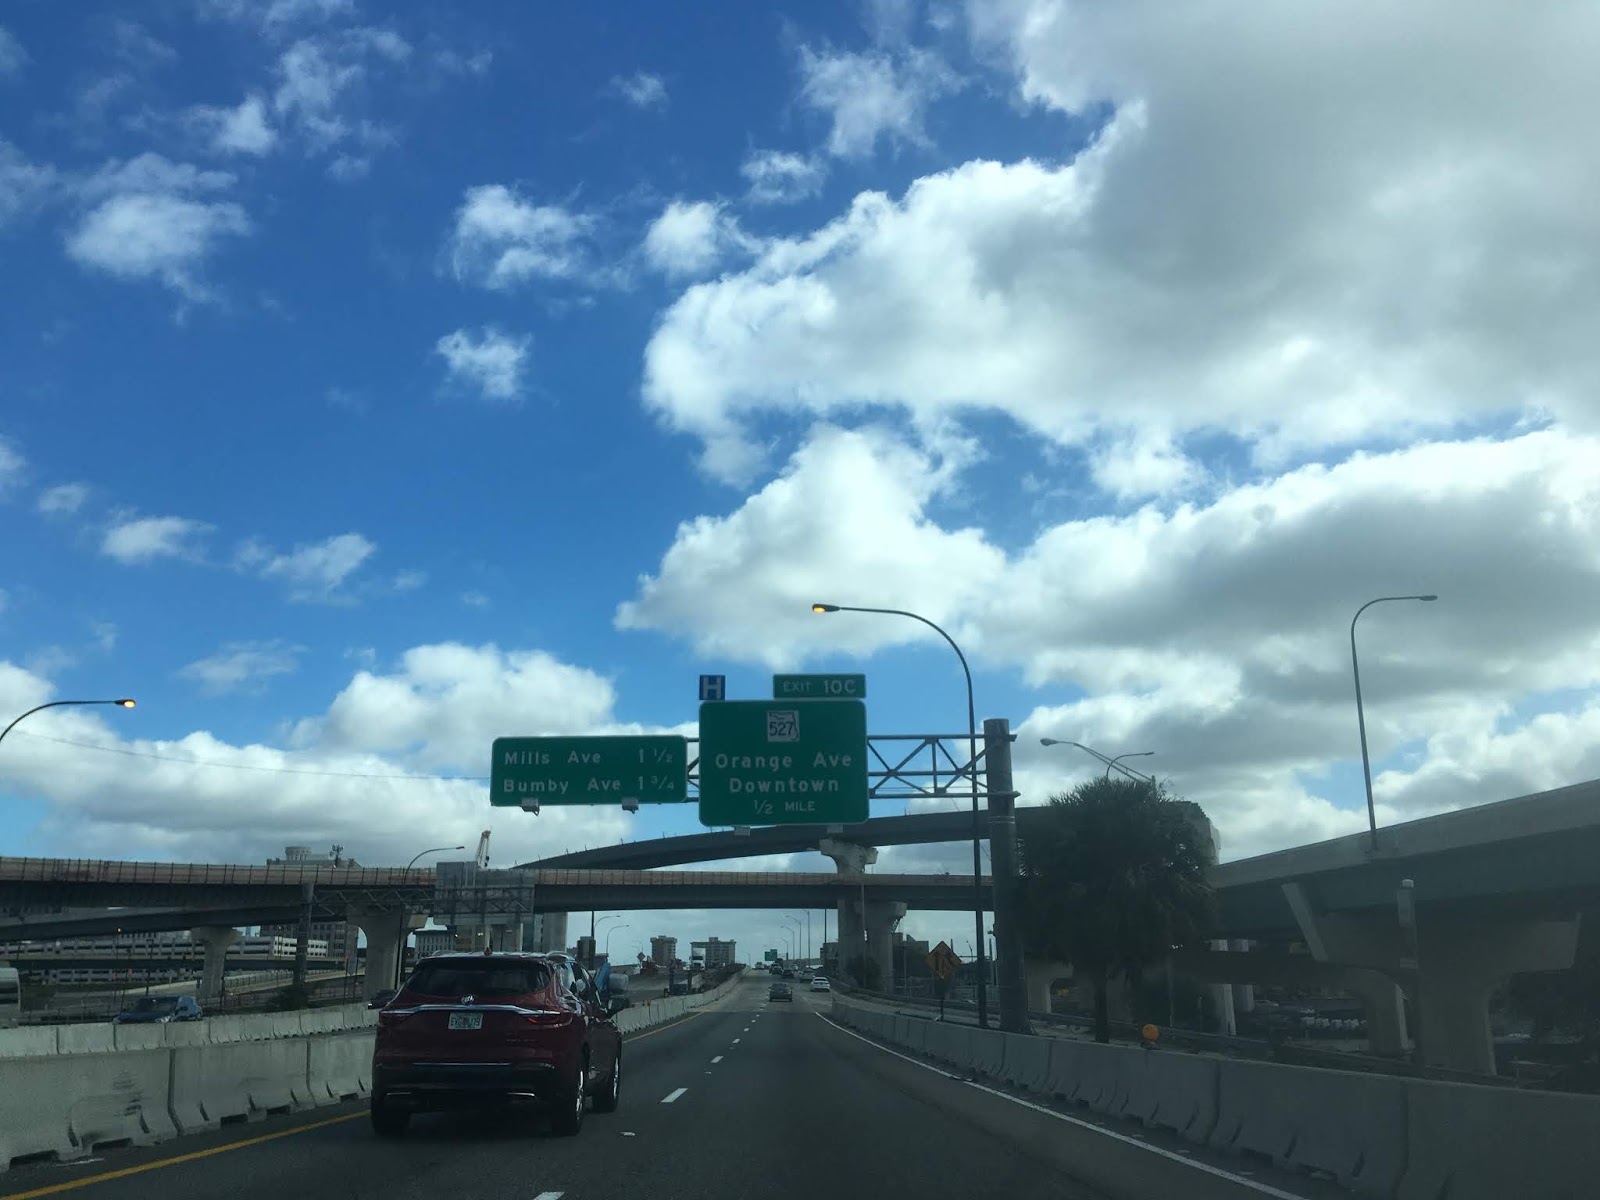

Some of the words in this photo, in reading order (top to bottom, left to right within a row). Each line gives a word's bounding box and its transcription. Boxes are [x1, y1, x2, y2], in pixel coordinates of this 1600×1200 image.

[703, 676, 721, 699] H
[783, 682, 811, 692] EXIT
[824, 680, 856, 694] 10C
[769, 721, 794, 737] 527
[504, 751, 550, 765] Mills
[567, 750, 601, 764] Ave
[716, 753, 792, 772] Orange
[813, 752, 852, 768] Ave
[503, 779, 569, 795] Bumby
[587, 777, 621, 791] Ave
[729, 777, 839, 793] Downtown
[785, 801, 815, 812] MILE
